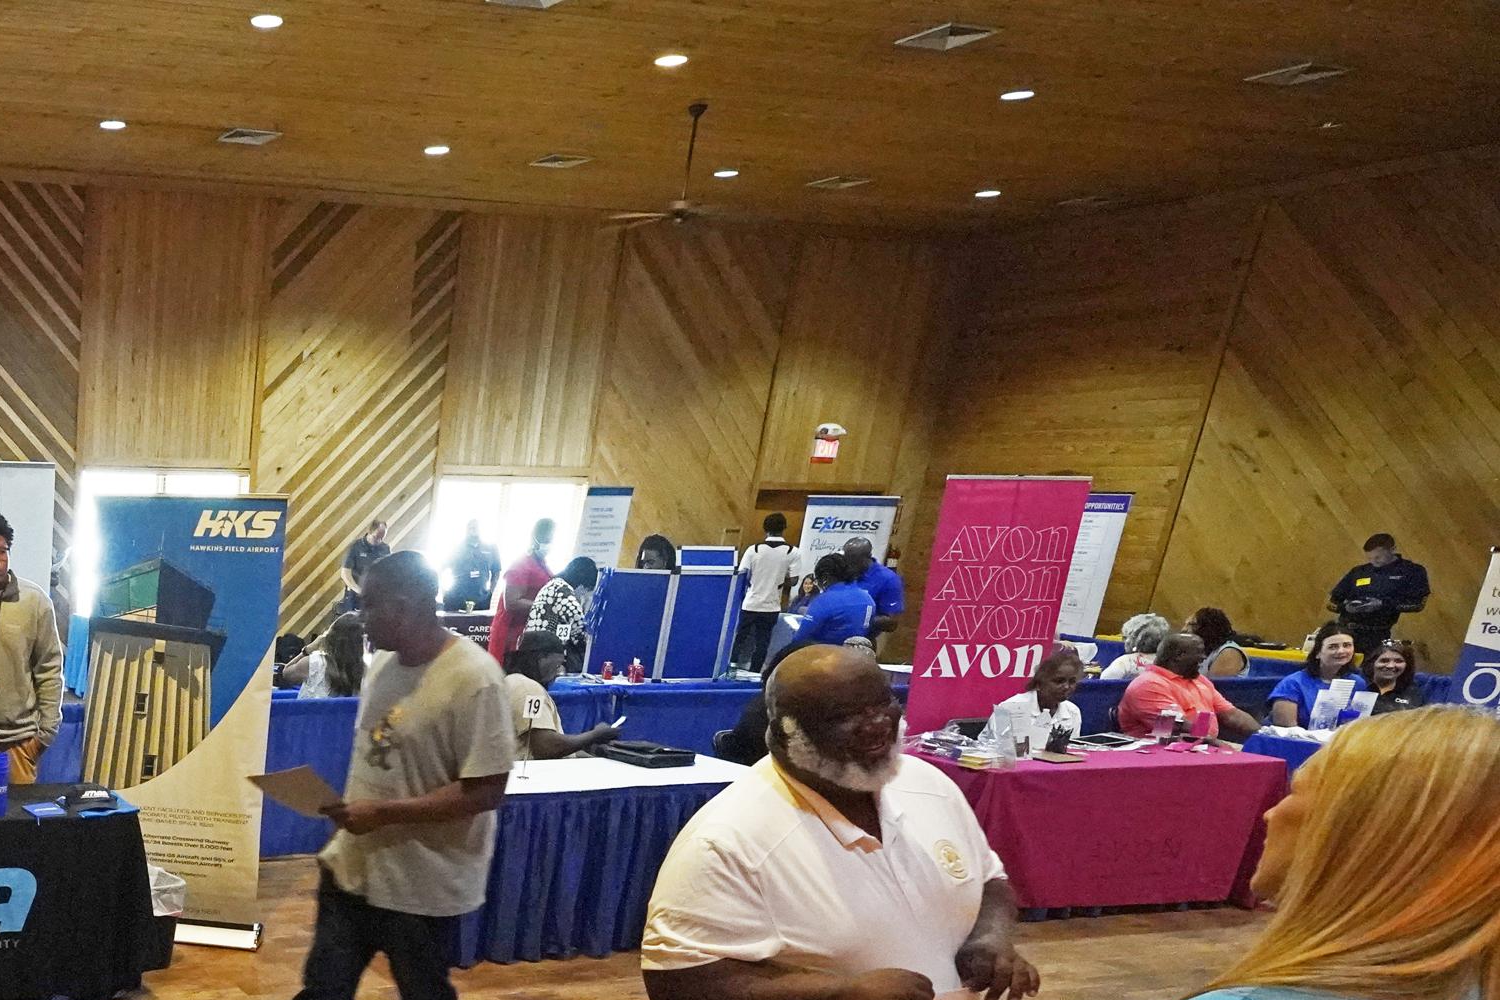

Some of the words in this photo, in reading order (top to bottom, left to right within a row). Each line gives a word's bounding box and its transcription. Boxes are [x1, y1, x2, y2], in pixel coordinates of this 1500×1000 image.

[1084, 502, 1125, 510] OPPORTUNITIES
[193, 510, 282, 538] HKS
[811, 515, 881, 533] Express
[225, 545, 245, 553] FIELD
[468, 625, 492, 633] CARE
[558, 627, 569, 637] 23
[920, 643, 1044, 679] AVON
[528, 698, 541, 715] 19
